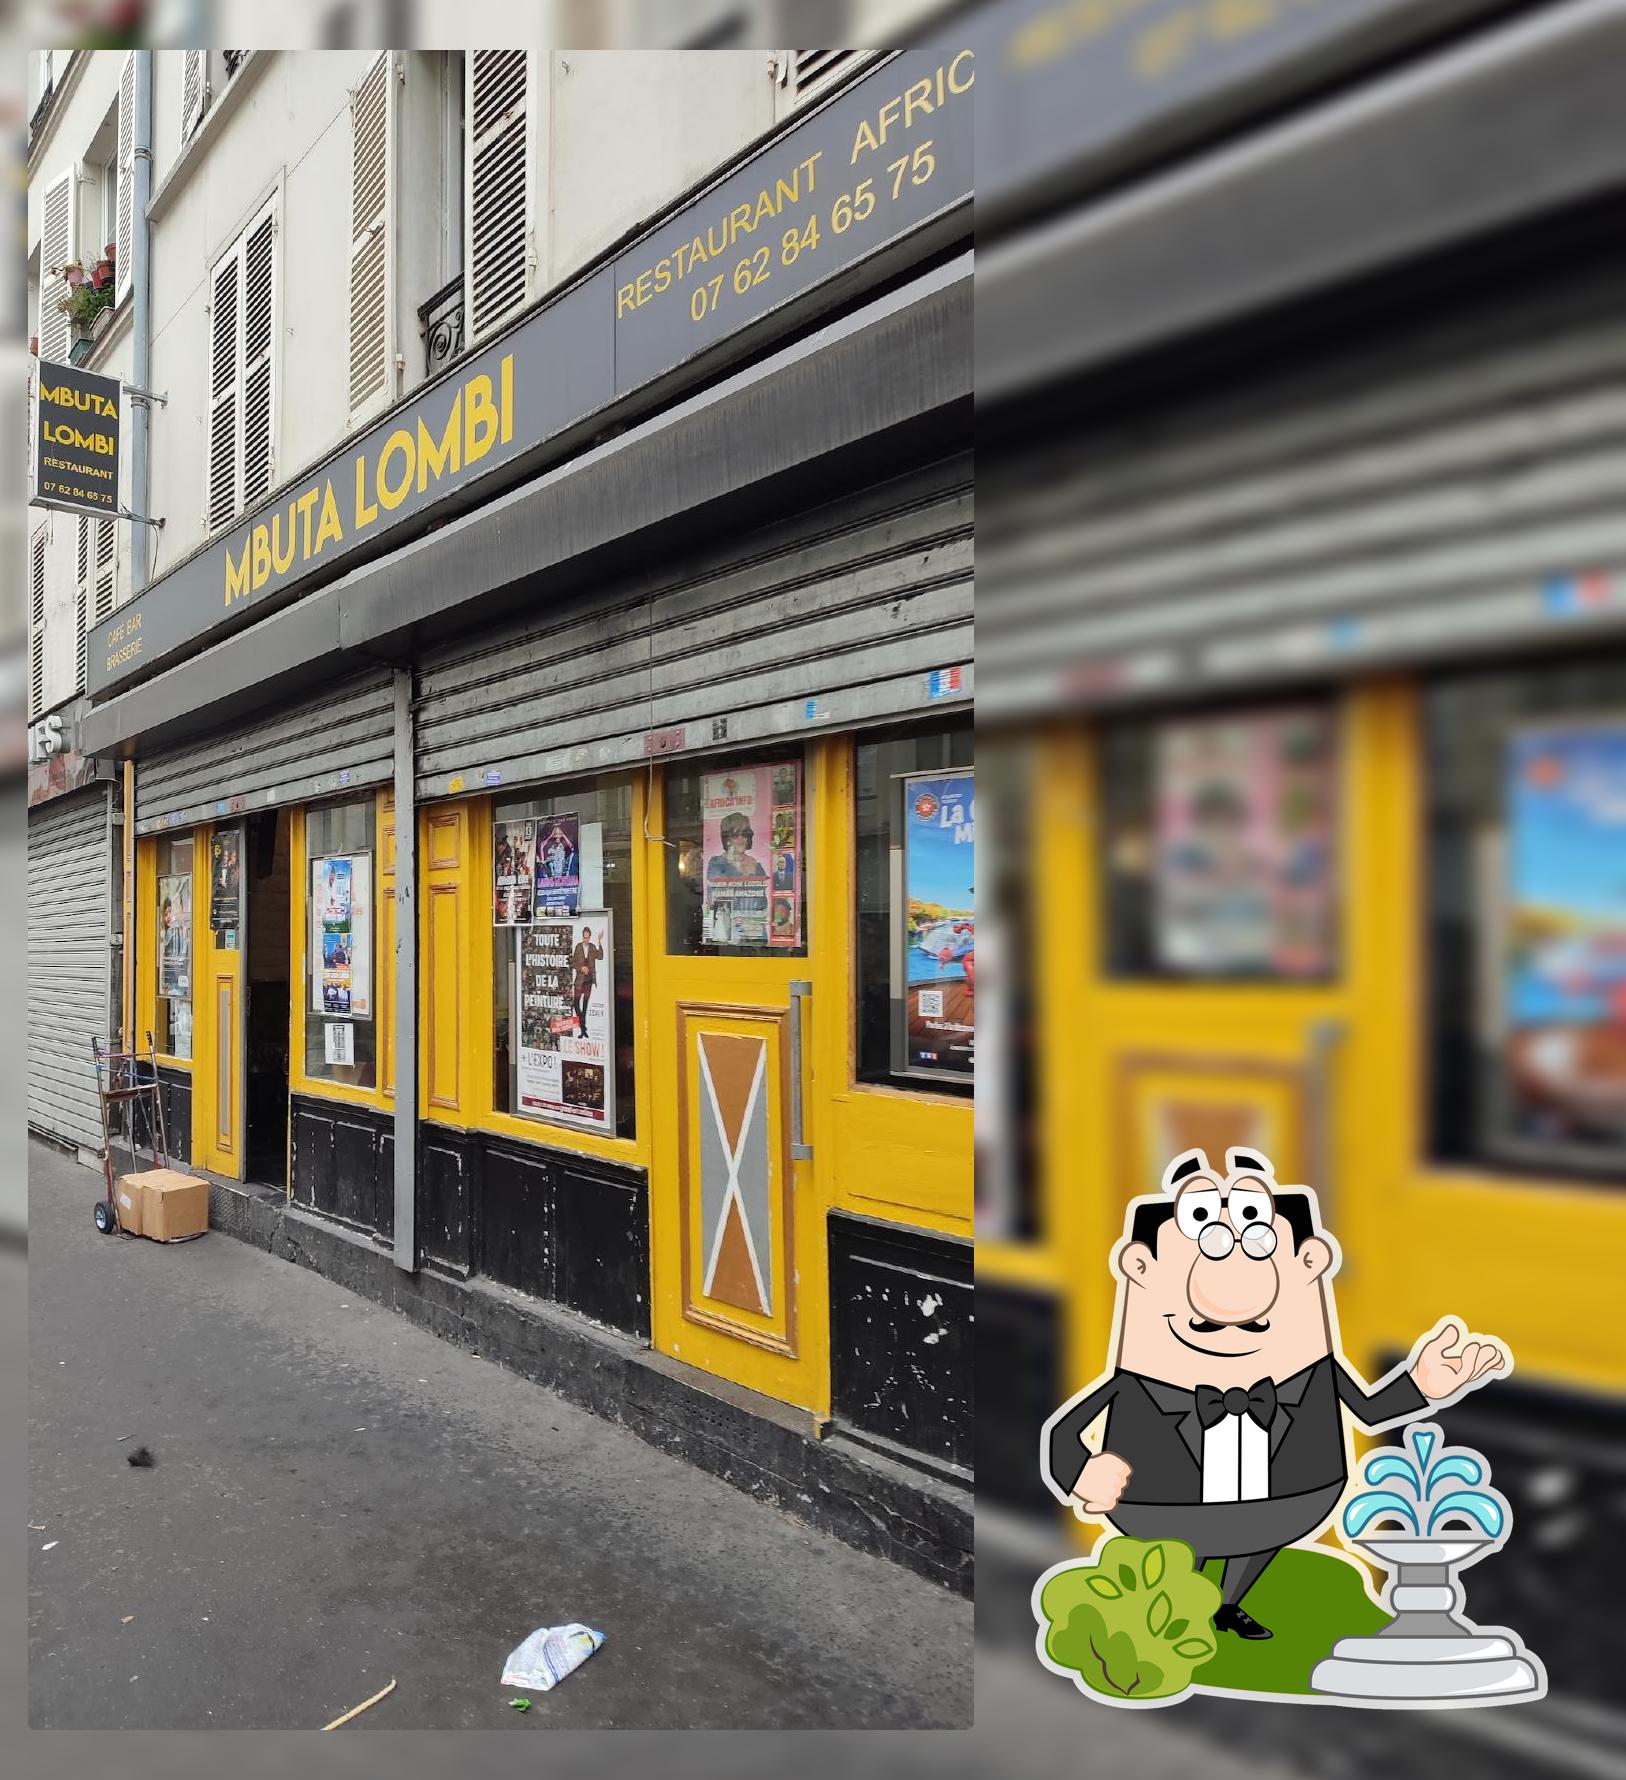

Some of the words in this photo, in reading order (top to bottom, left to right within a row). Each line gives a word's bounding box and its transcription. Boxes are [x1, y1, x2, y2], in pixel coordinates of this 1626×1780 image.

[617, 151, 823, 320] RESTAURANT
[850, 49, 974, 166] AFRIC
[690, 274, 724, 321] 07
[733, 247, 770, 295] 62
[781, 214, 820, 266] 84
[831, 178, 876, 234] 65
[887, 140, 936, 200] 75
[40, 381, 118, 420] MBUTA
[43, 420, 114, 456] LOMBI
[43, 456, 114, 480] RESTAURANT
[225, 478, 343, 607] MBUTA
[355, 353, 513, 529] LOMBI
[43, 481, 56, 491] 07
[58, 484, 71, 495] 62
[72, 487, 85, 498] 84
[86, 490, 99, 501] 65
[100, 494, 113, 503] 75
[127, 613, 142, 635] BAR
[107, 637, 142, 671] BRASSERIE
[940, 804, 964, 828] La
[532, 933, 560, 947] TOUTE
[525, 953, 569, 968] L'HISTOIRE
[535, 974, 547, 987] DE
[548, 975, 559, 988] LA
